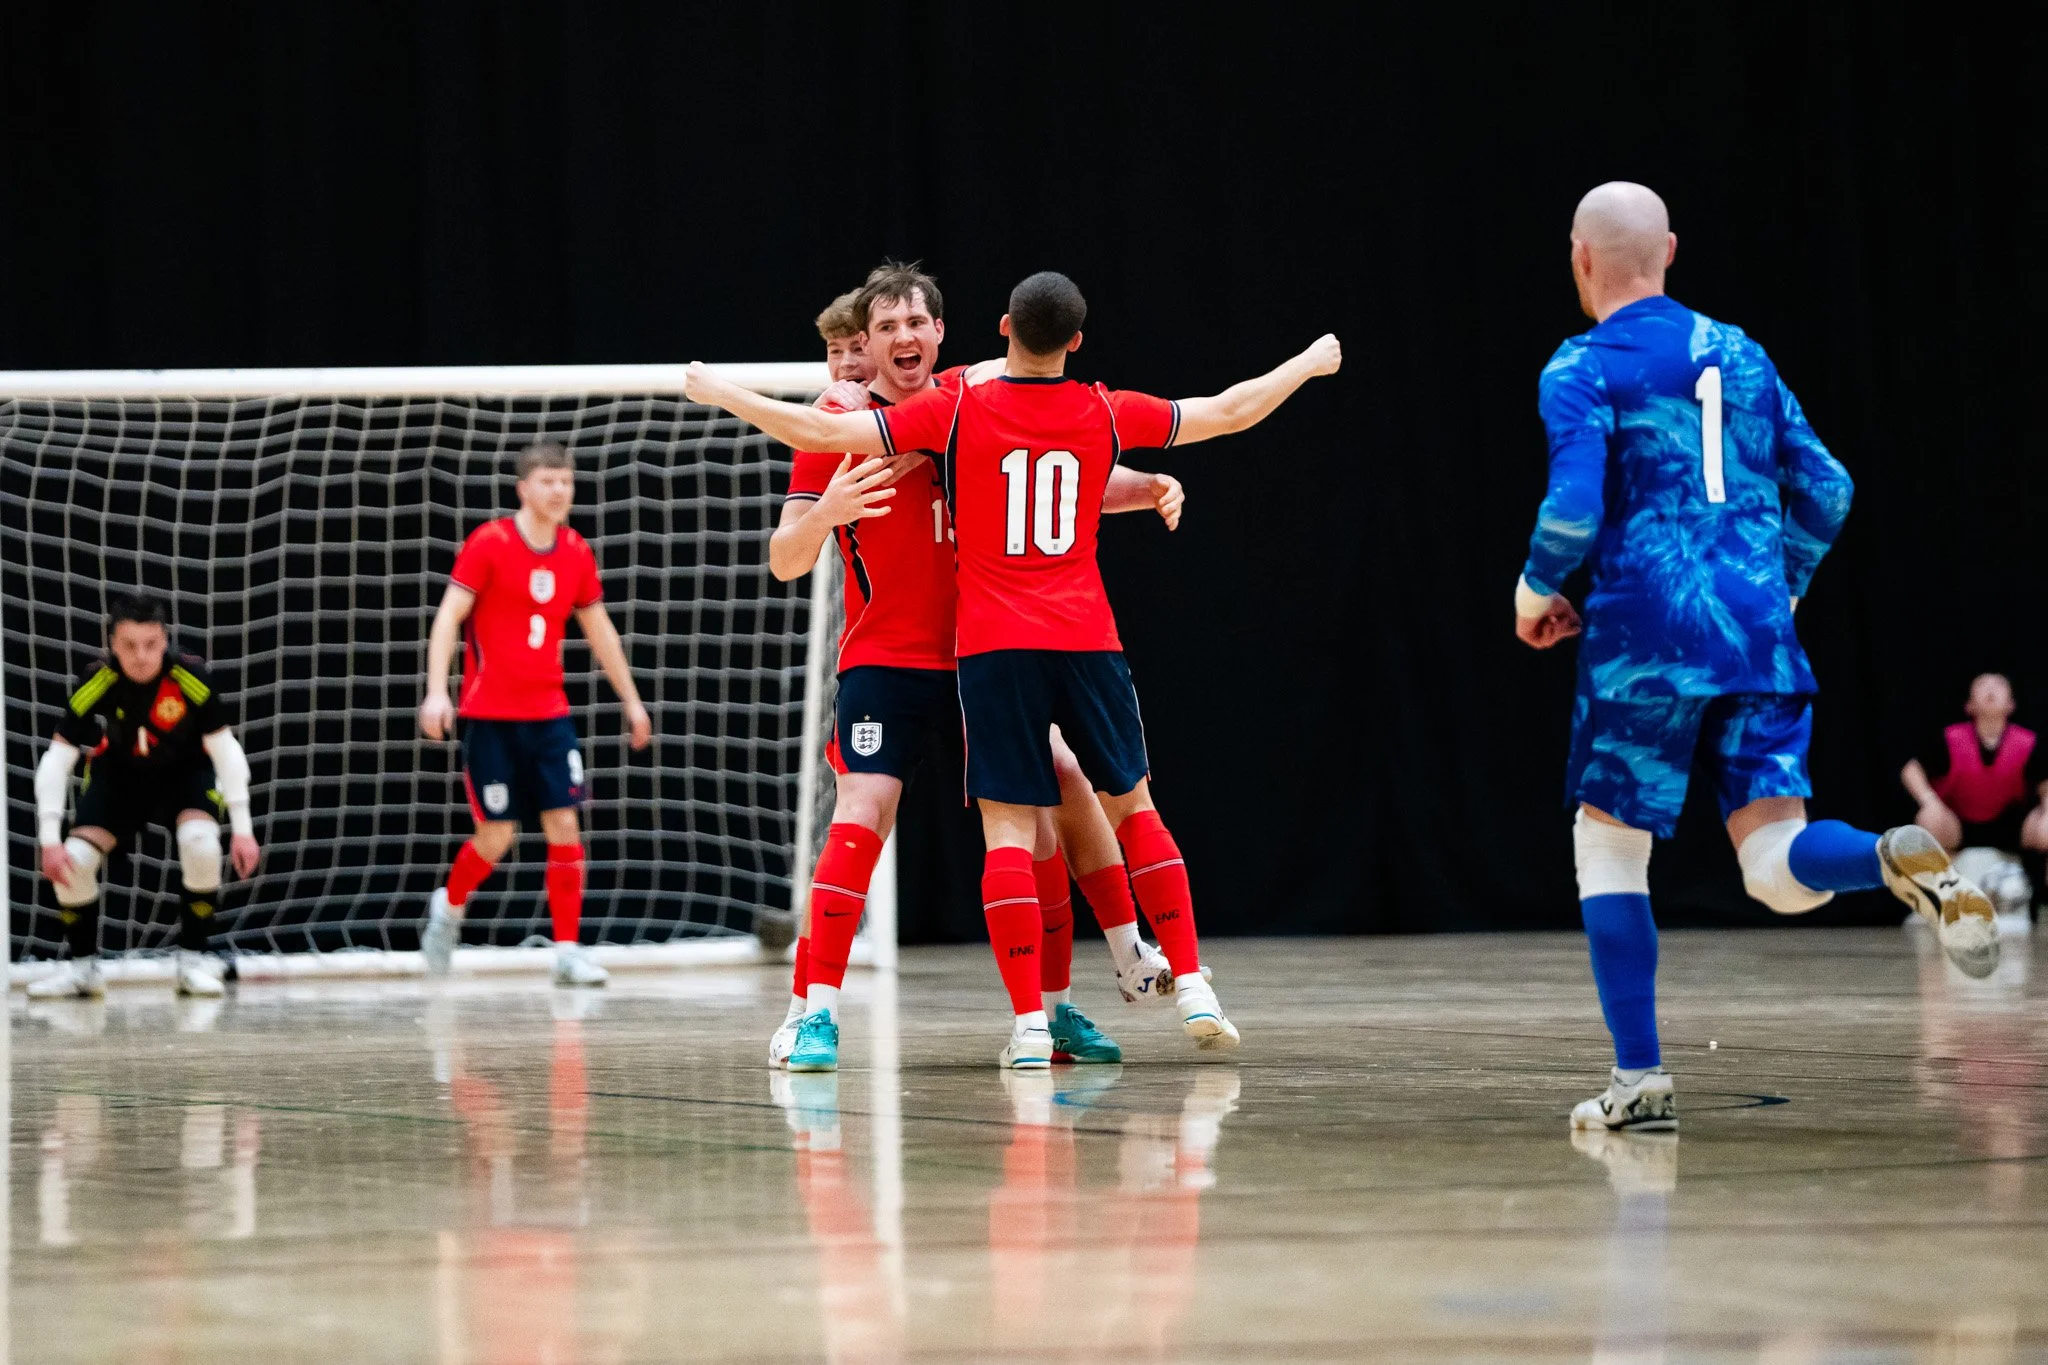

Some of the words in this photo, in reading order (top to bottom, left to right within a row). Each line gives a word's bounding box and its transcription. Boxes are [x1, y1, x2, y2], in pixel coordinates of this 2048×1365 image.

[1695, 366, 1726, 503] 1
[932, 499, 955, 544] 1
[1000, 448, 1080, 556] 10
[1154, 909, 1180, 925] ENG
[1009, 944, 1035, 958] ENG
